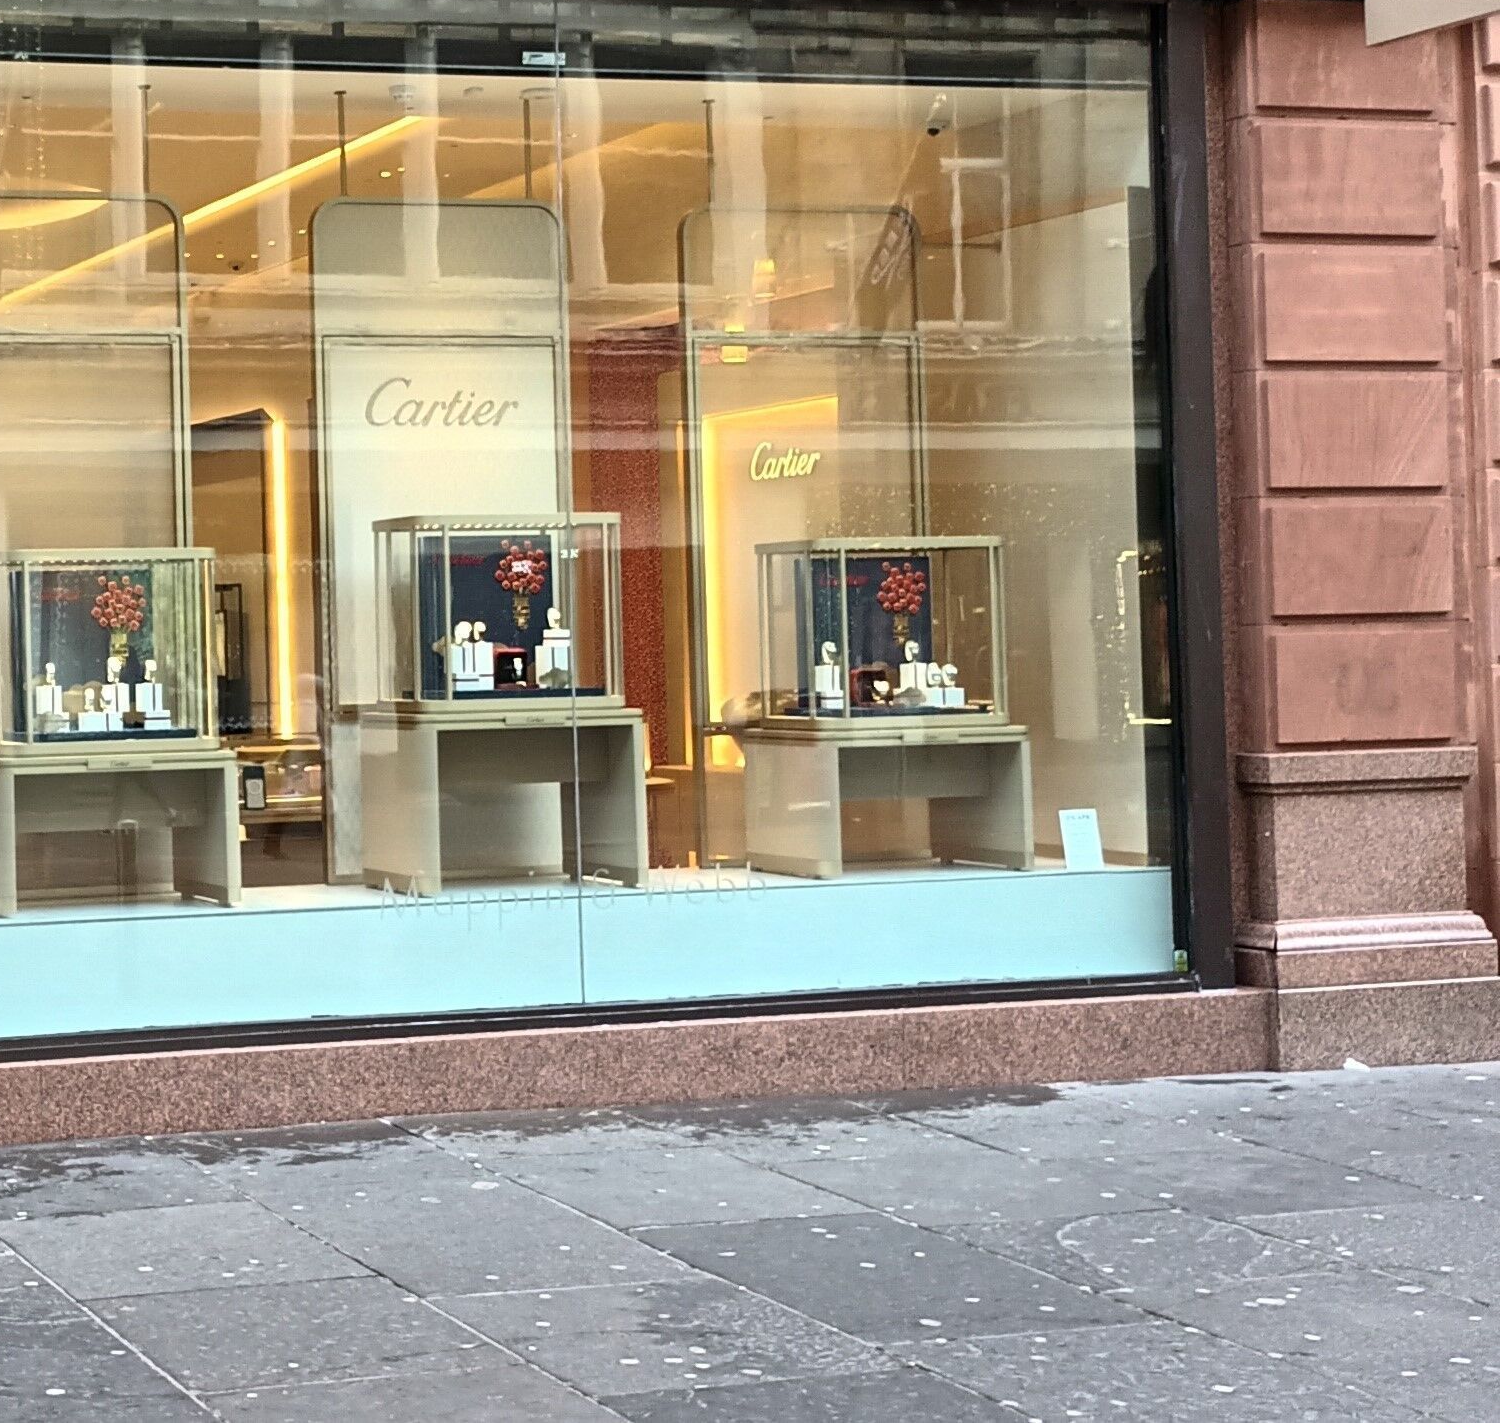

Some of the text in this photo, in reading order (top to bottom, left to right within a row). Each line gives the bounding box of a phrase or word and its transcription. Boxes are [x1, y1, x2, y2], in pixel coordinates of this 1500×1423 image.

[364, 377, 520, 427] Cartier
[749, 441, 821, 480] Cartier
[380, 870, 564, 931] Mappin
[645, 860, 767, 908] Webb
